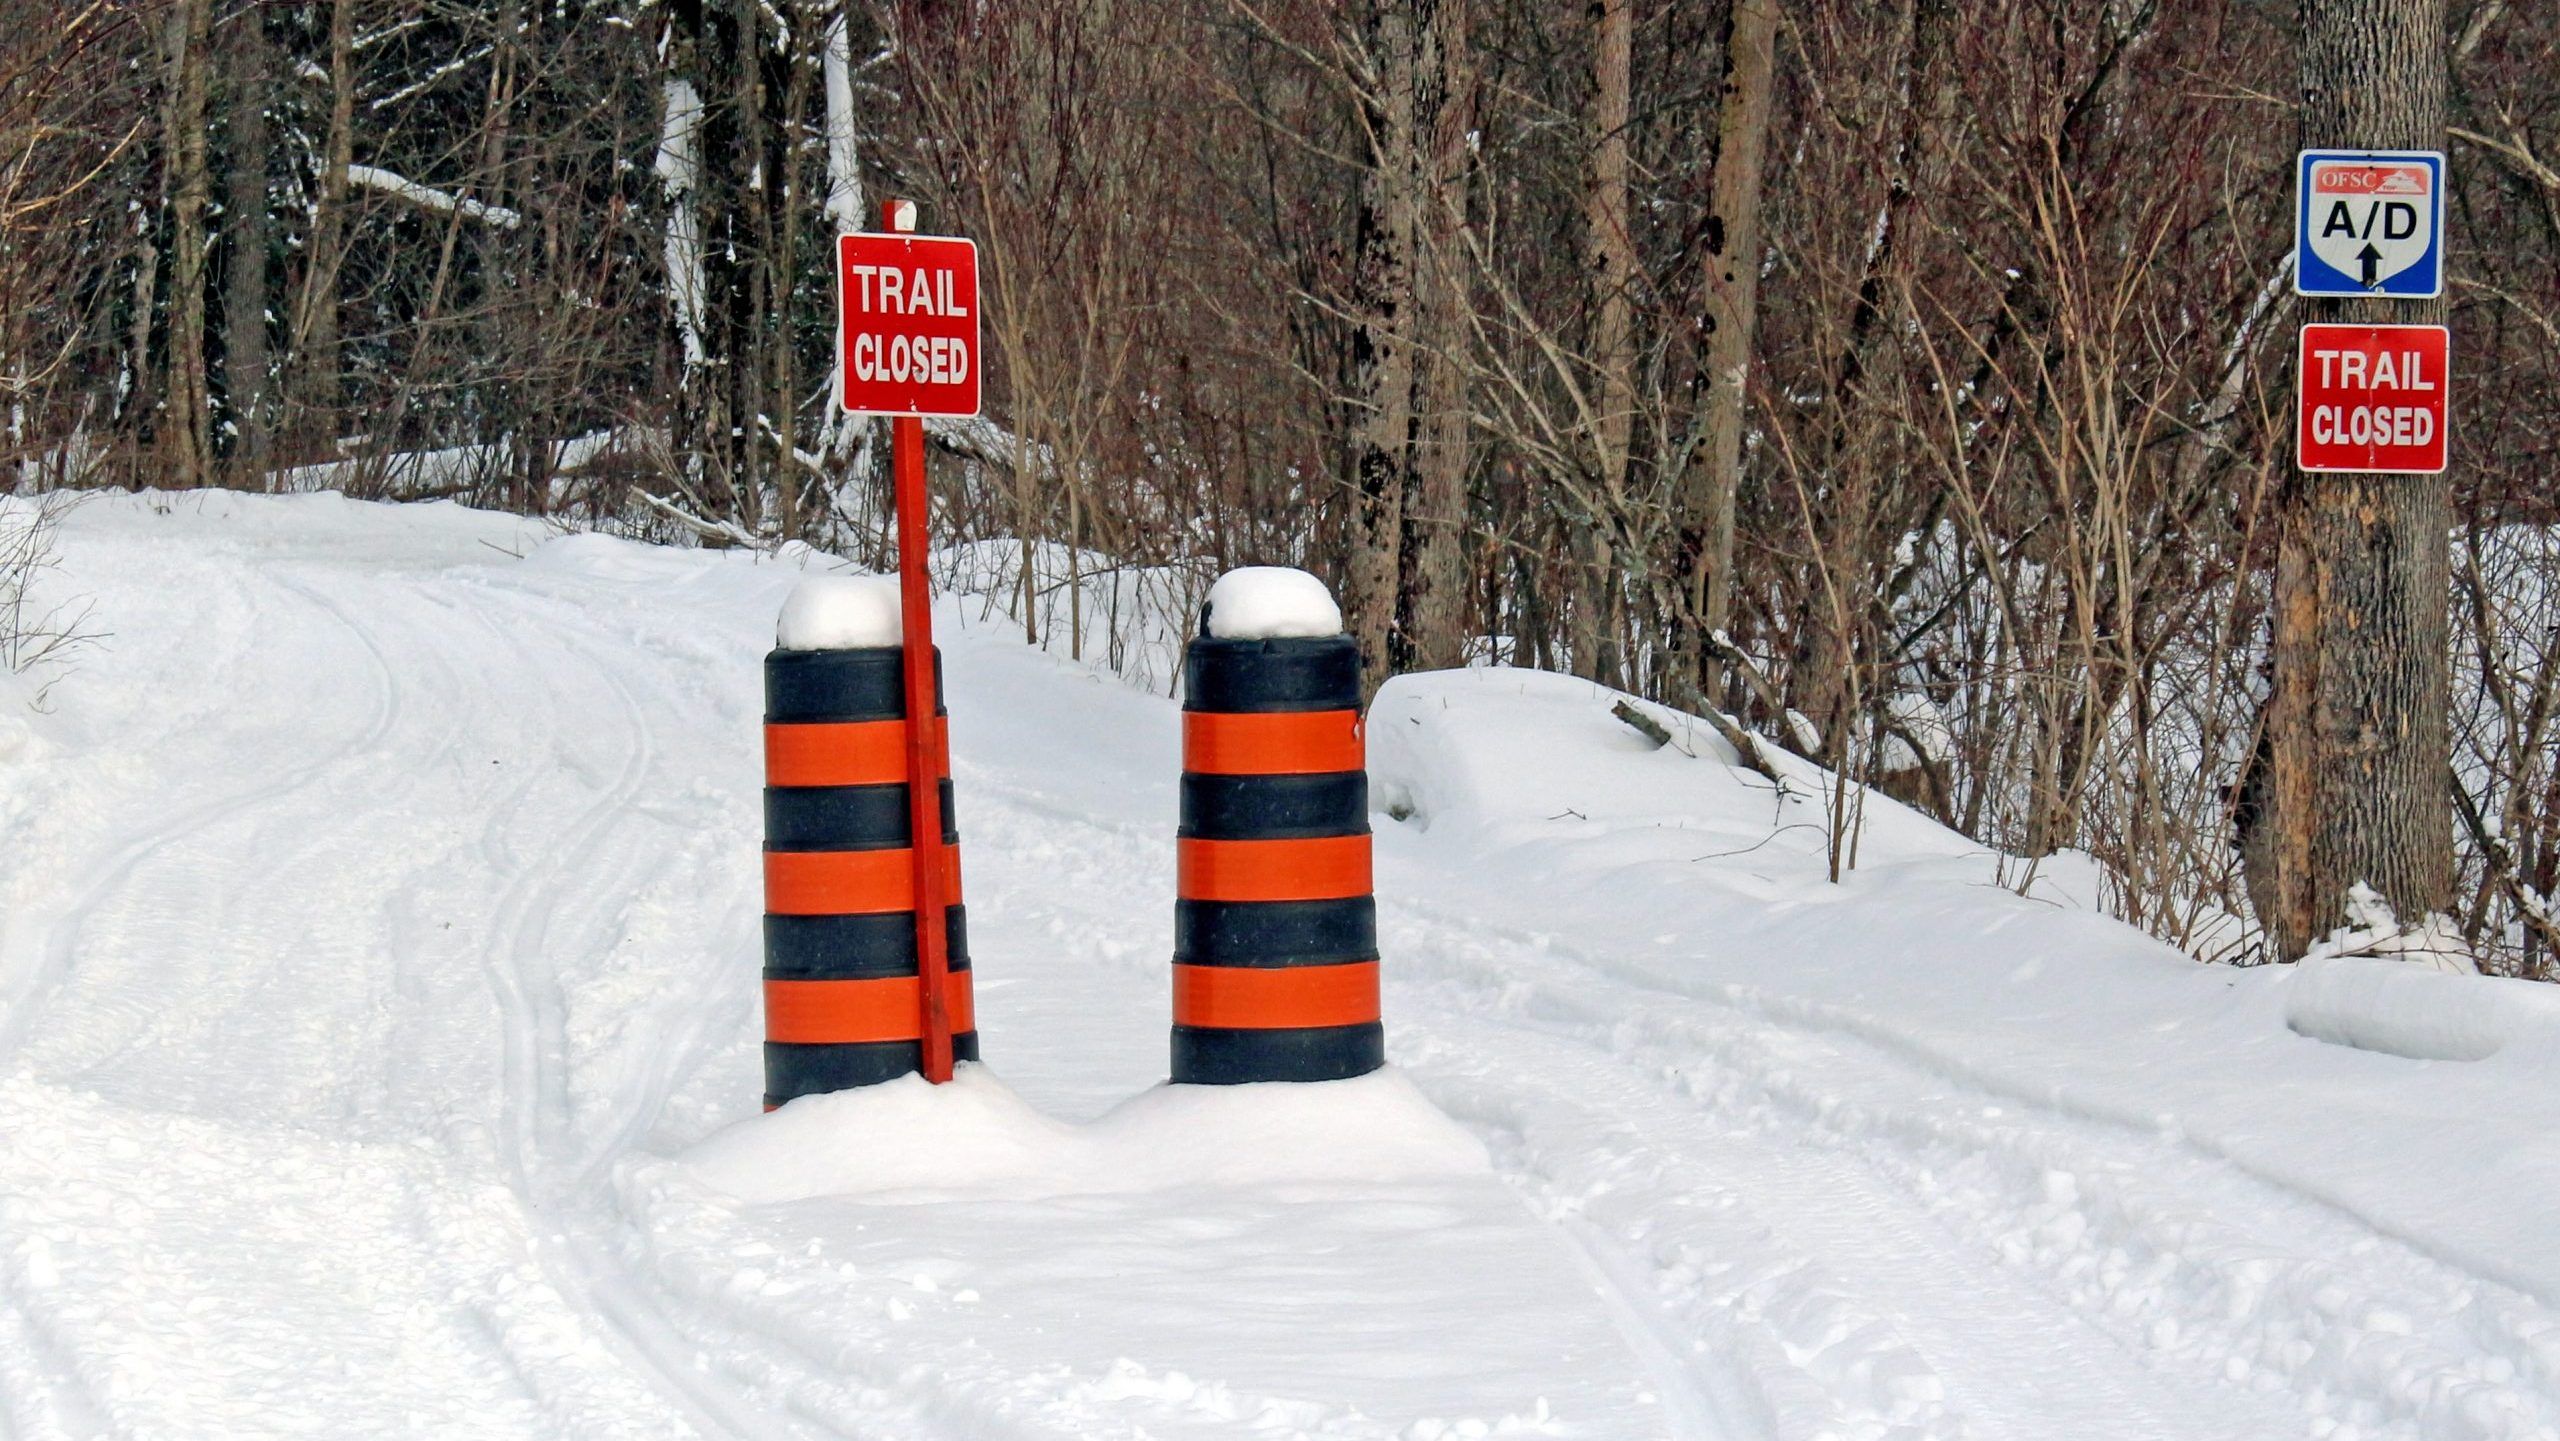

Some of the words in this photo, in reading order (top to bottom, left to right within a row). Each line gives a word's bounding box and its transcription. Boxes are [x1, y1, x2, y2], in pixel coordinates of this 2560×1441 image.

[2321, 171, 2377, 188] OFSC
[2322, 201, 2417, 240] A/D
[852, 265, 968, 318] TRAIL
[854, 332, 968, 385] CLOSED
[2313, 350, 2435, 391] TRAIL
[2312, 404, 2434, 446] CLOSED
